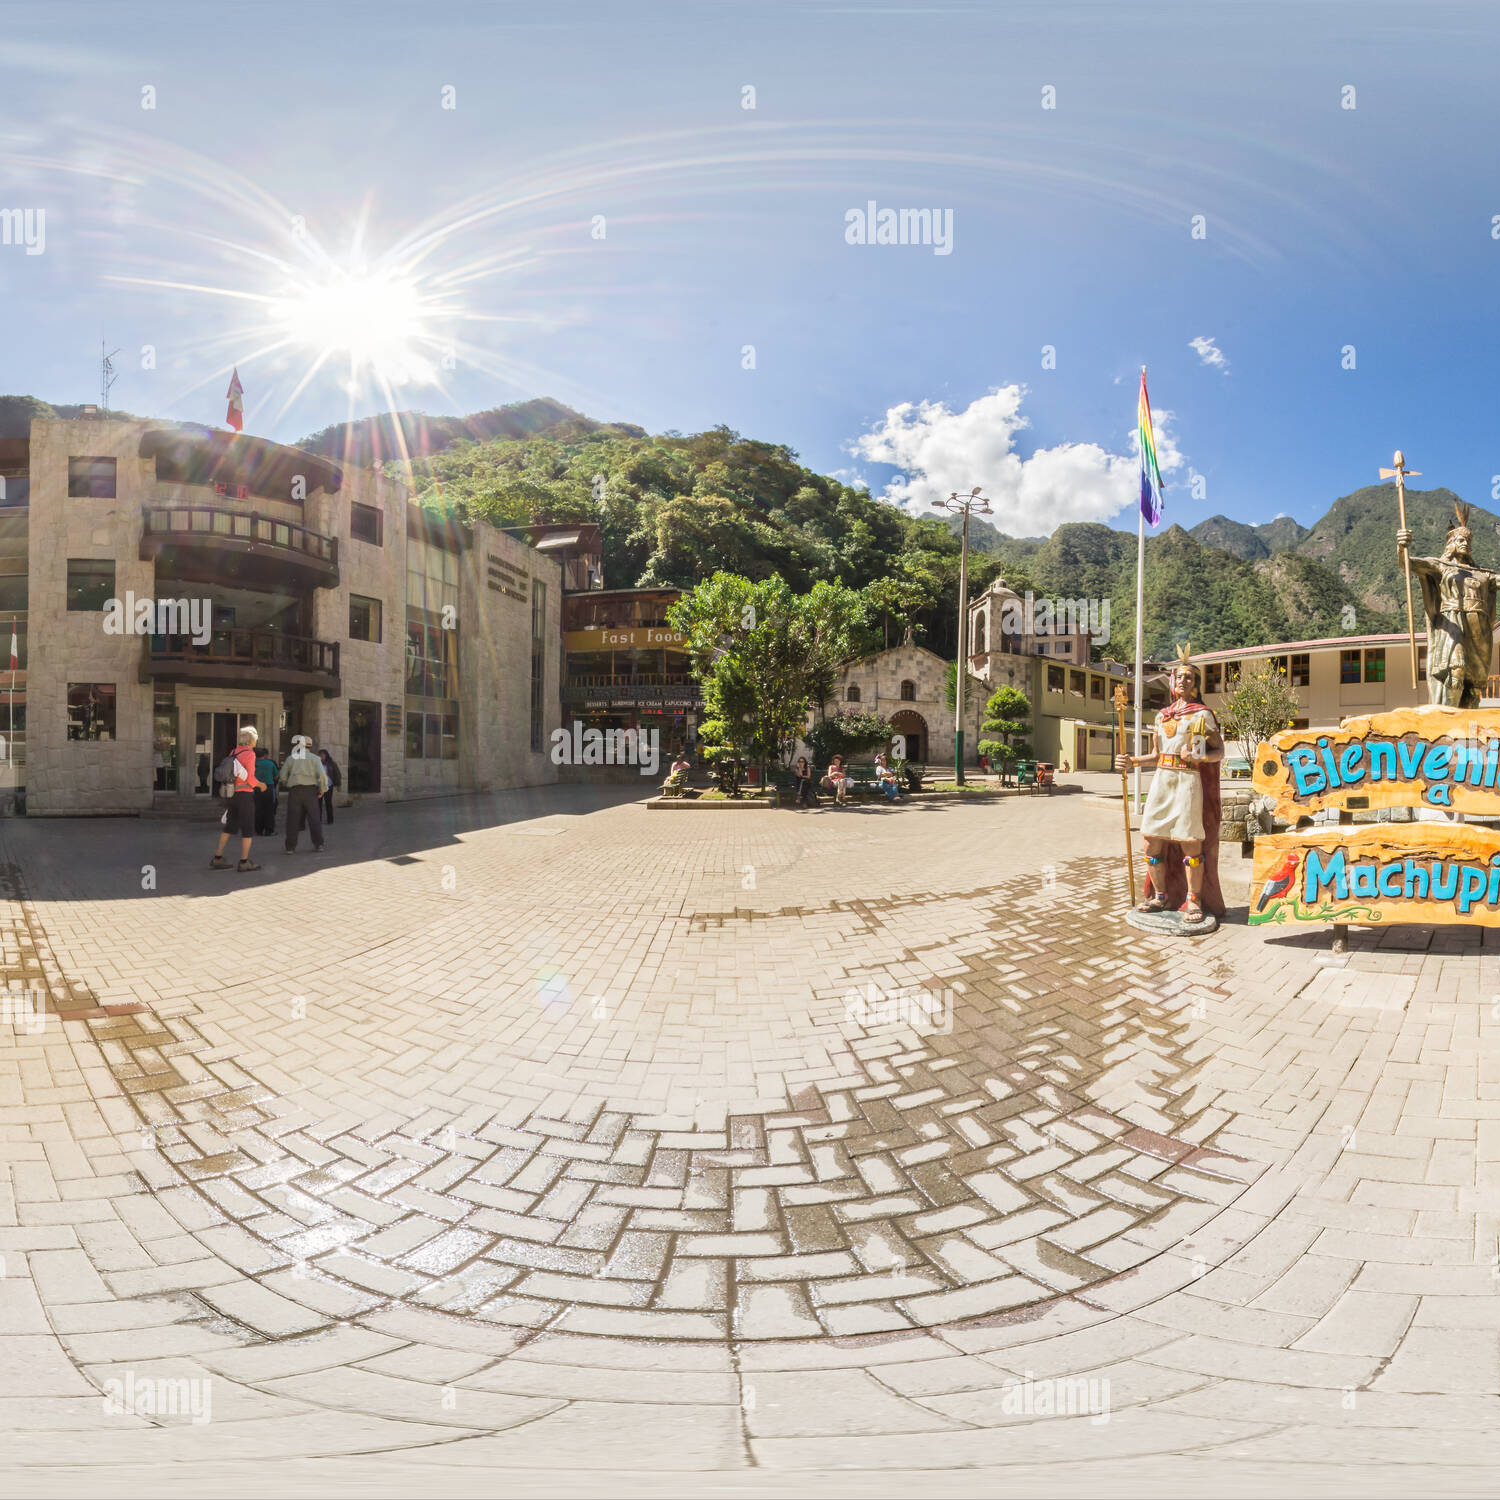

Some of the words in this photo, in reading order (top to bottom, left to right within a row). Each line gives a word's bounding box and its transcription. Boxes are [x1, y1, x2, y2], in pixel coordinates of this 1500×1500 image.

[601, 630, 635, 644] Fast
[647, 629, 683, 643] Food
[1427, 783, 1451, 807] a
